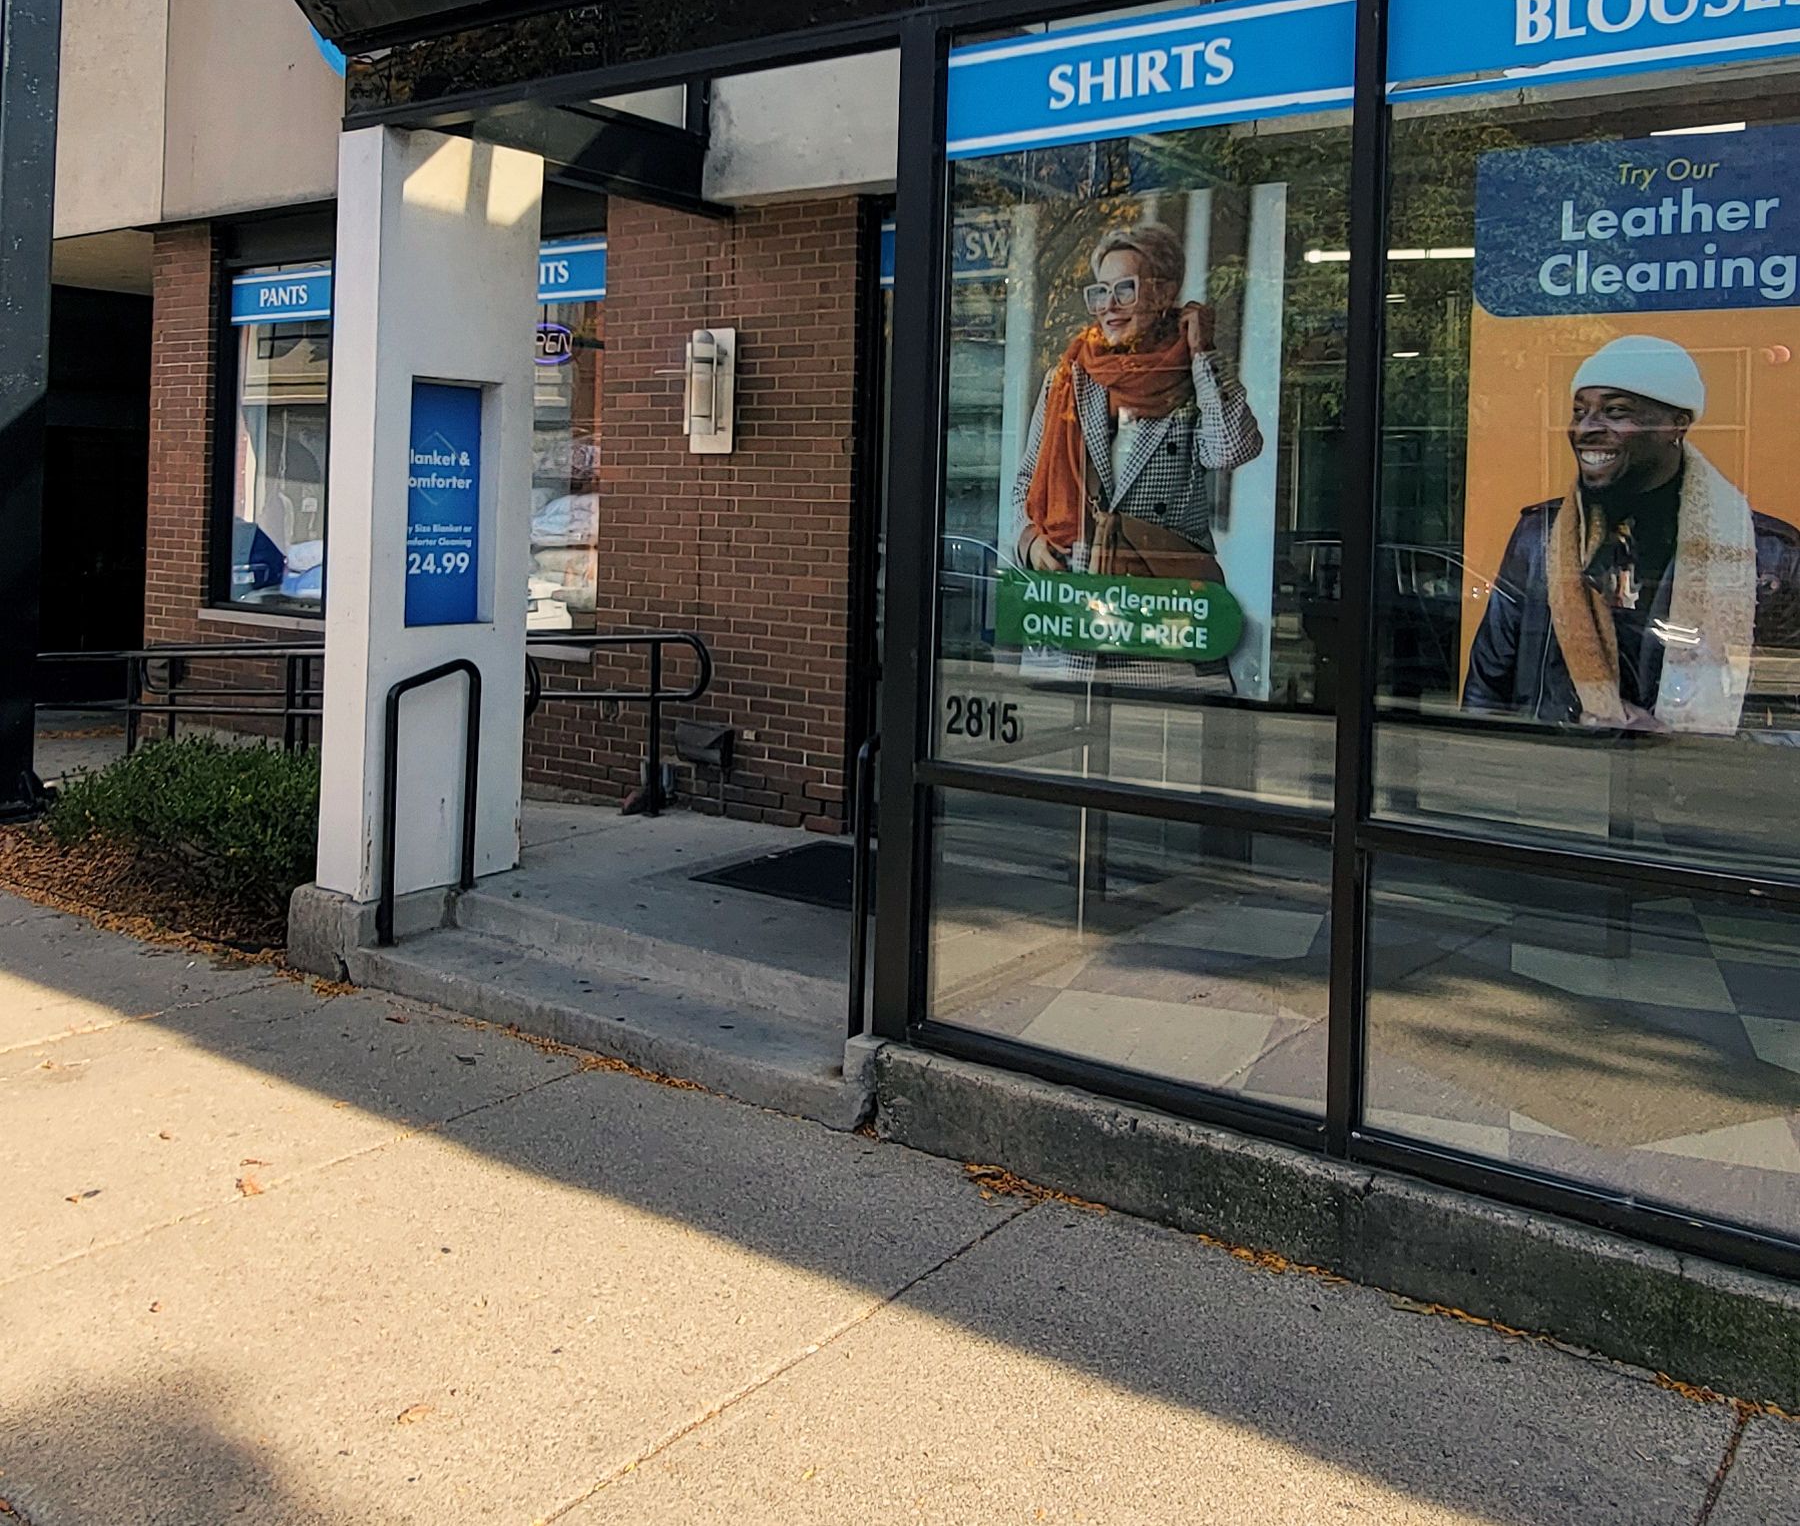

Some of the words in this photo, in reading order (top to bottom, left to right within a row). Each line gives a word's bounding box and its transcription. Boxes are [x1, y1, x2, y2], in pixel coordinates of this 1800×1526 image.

[1048, 37, 1234, 110] SHIRTS
[1618, 162, 1657, 192] Try
[1666, 157, 1720, 182] Our
[1560, 187, 1780, 241] Leather
[1538, 242, 1797, 300] Cleaning
[259, 284, 308, 308] PANTS
[459, 451, 471, 467] &
[1023, 580, 1052, 602] All
[1058, 583, 1099, 612] Dry
[1105, 585, 1209, 620] Cleaning
[1022, 612, 1073, 638] ONE
[1079, 618, 1134, 642] LOW
[1141, 622, 1208, 649] PRICE
[946, 695, 1019, 744] 2815
